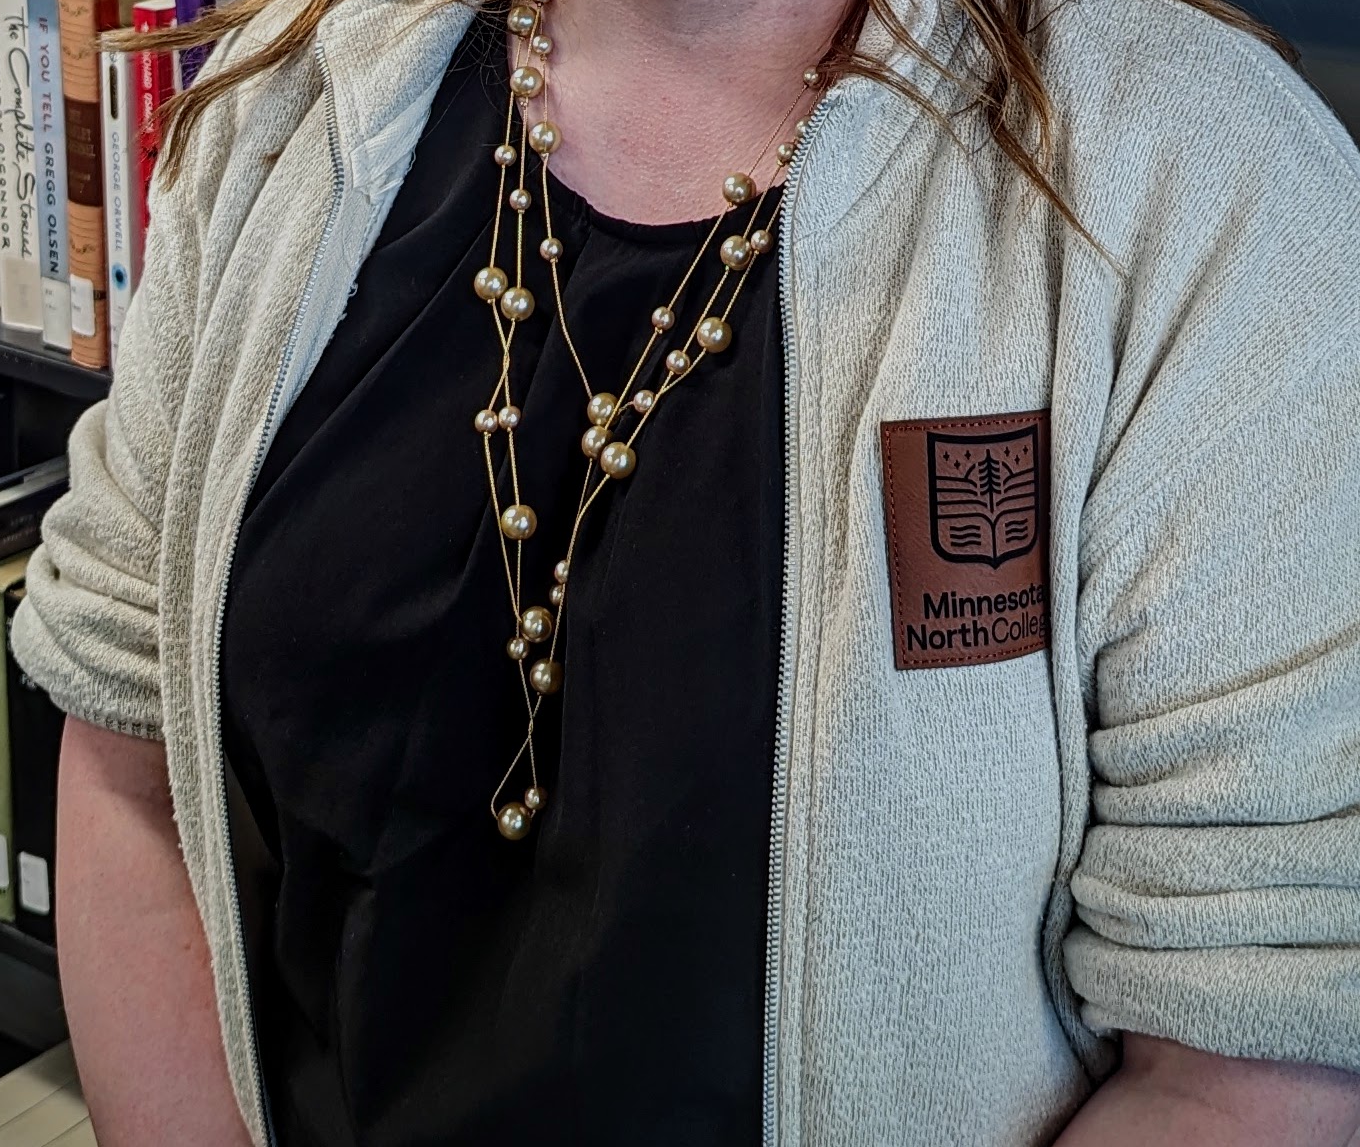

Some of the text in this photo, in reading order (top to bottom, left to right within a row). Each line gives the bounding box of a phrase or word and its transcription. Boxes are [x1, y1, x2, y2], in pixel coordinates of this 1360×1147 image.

[111, 131, 123, 252] GEORGE ORWELL
[923, 582, 1047, 620] Minnesota
